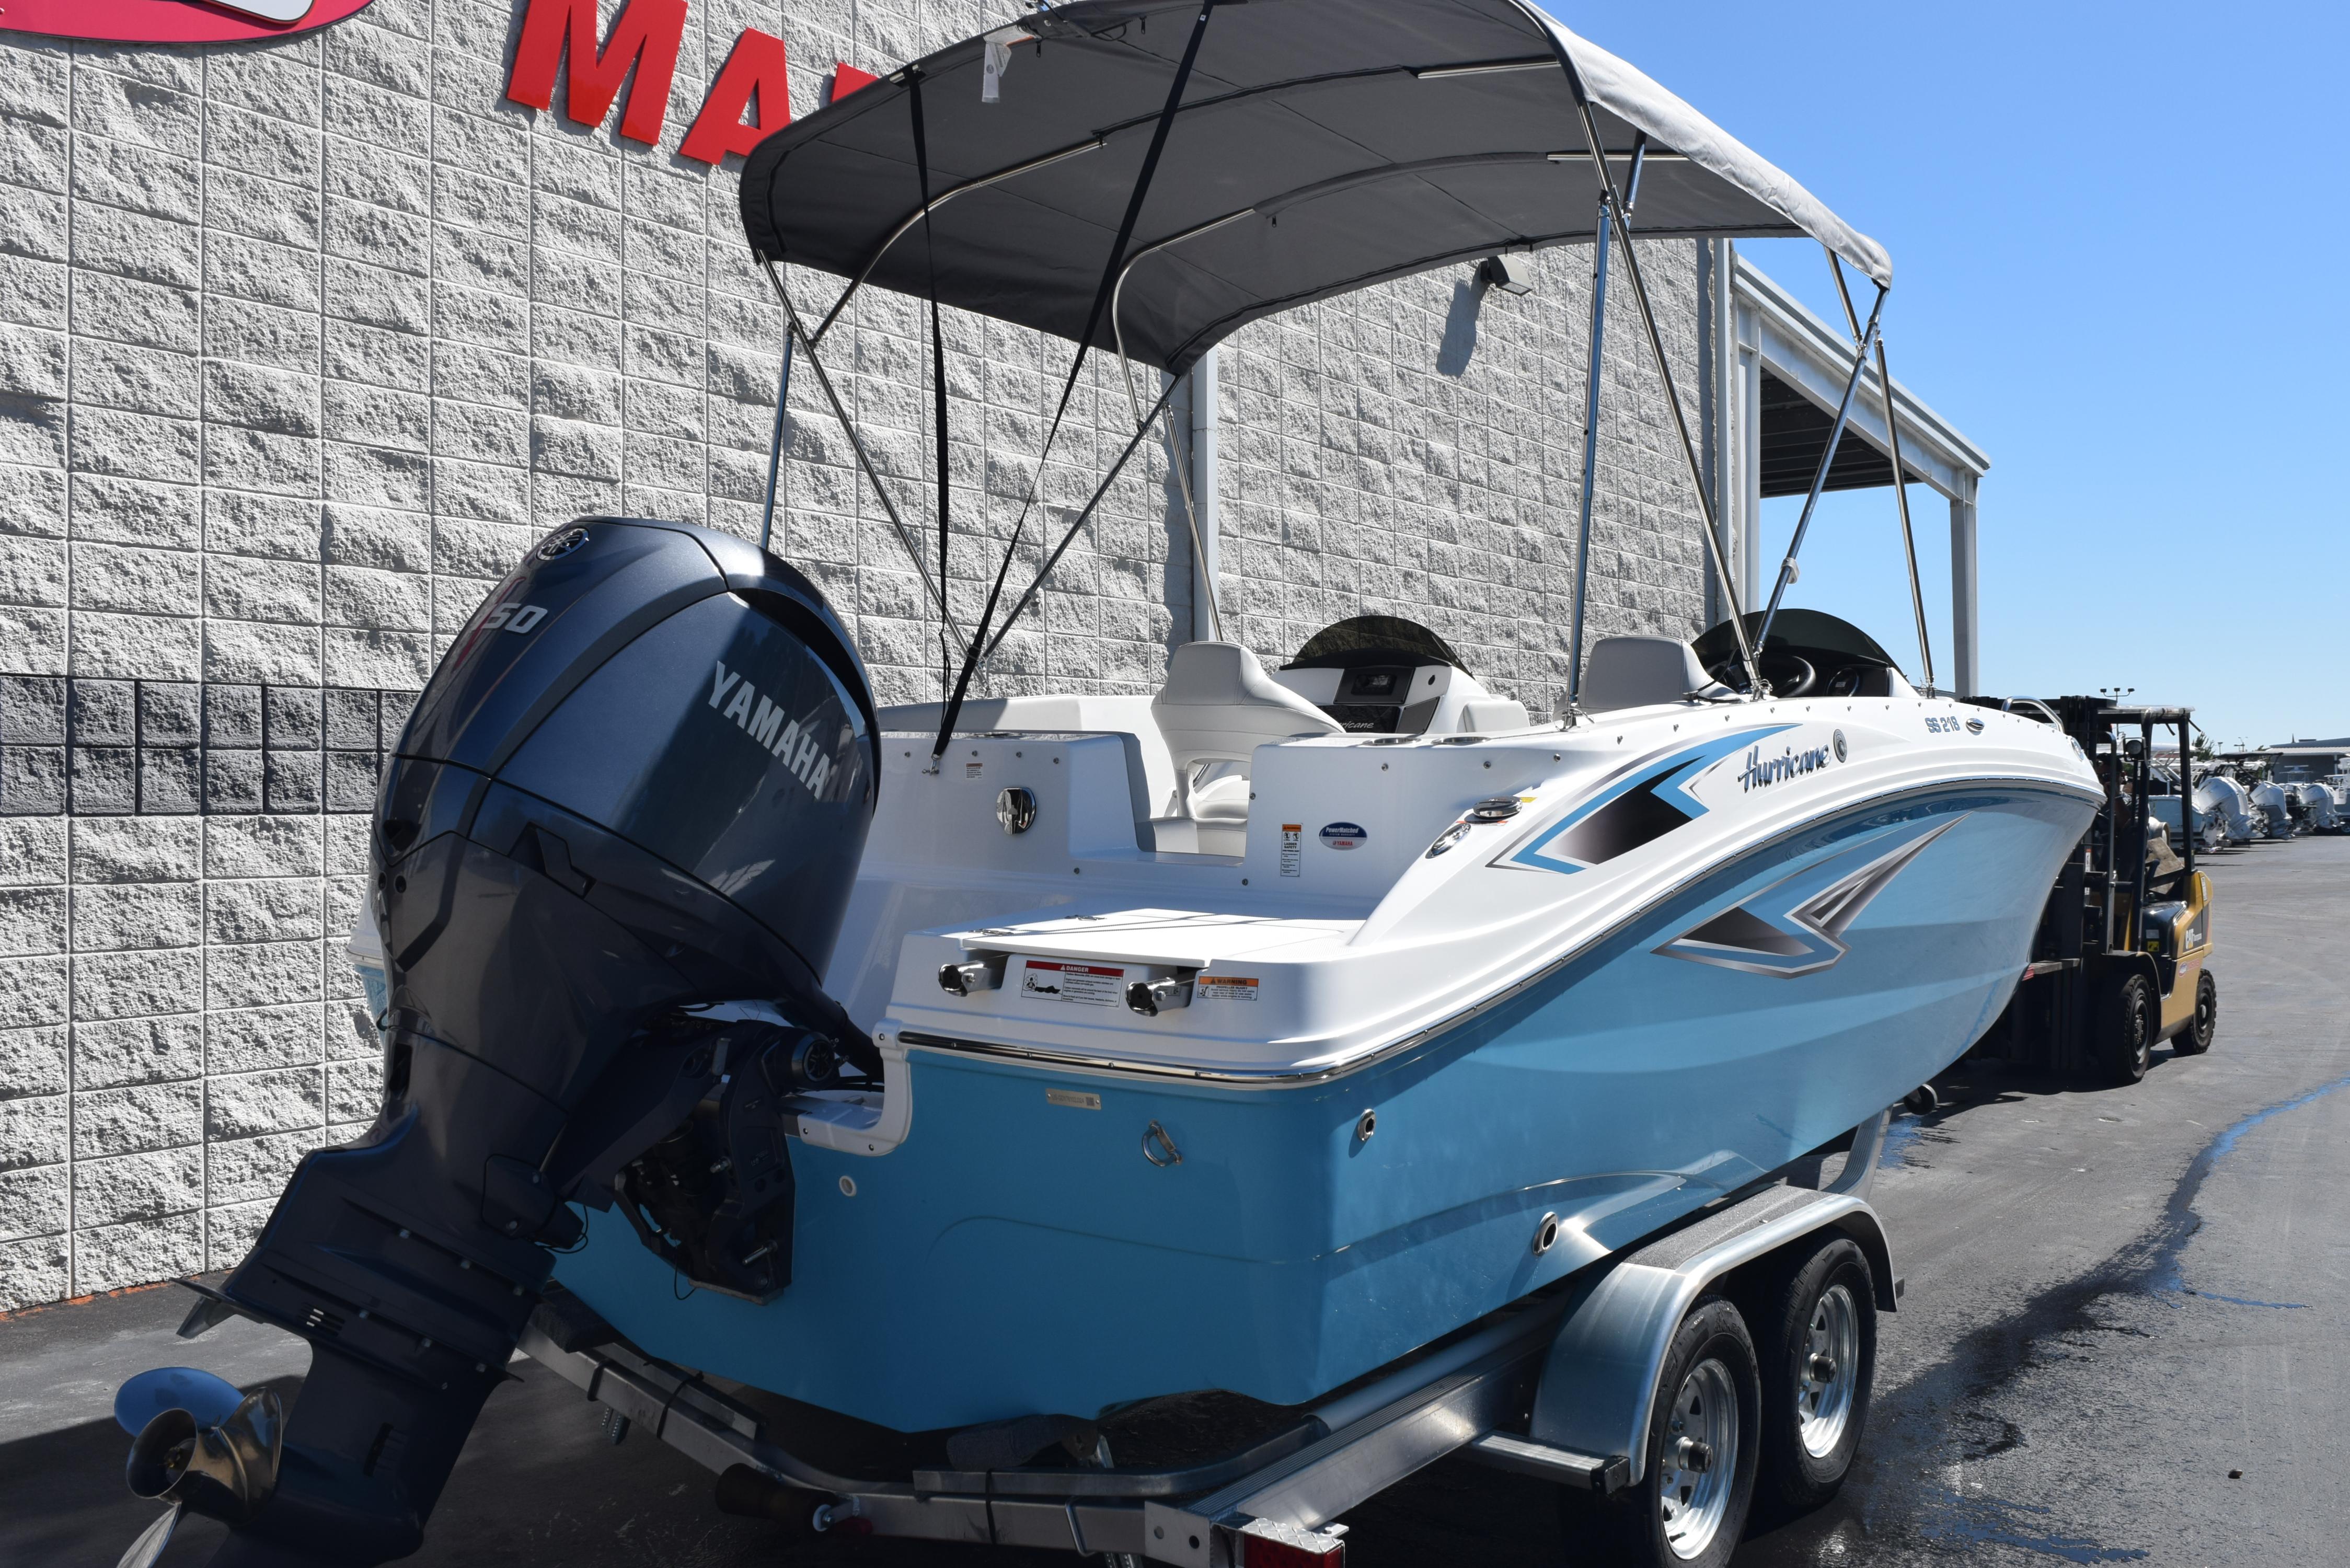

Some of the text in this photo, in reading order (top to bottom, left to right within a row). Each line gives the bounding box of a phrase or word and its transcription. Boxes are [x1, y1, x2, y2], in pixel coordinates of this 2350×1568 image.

[506, 0, 882, 165] MA
[708, 660, 830, 800] YAMAHA
[1925, 716, 1961, 733] SS 218
[1737, 744, 1831, 794] Hurricane
[2185, 928, 2194, 949] CAT
